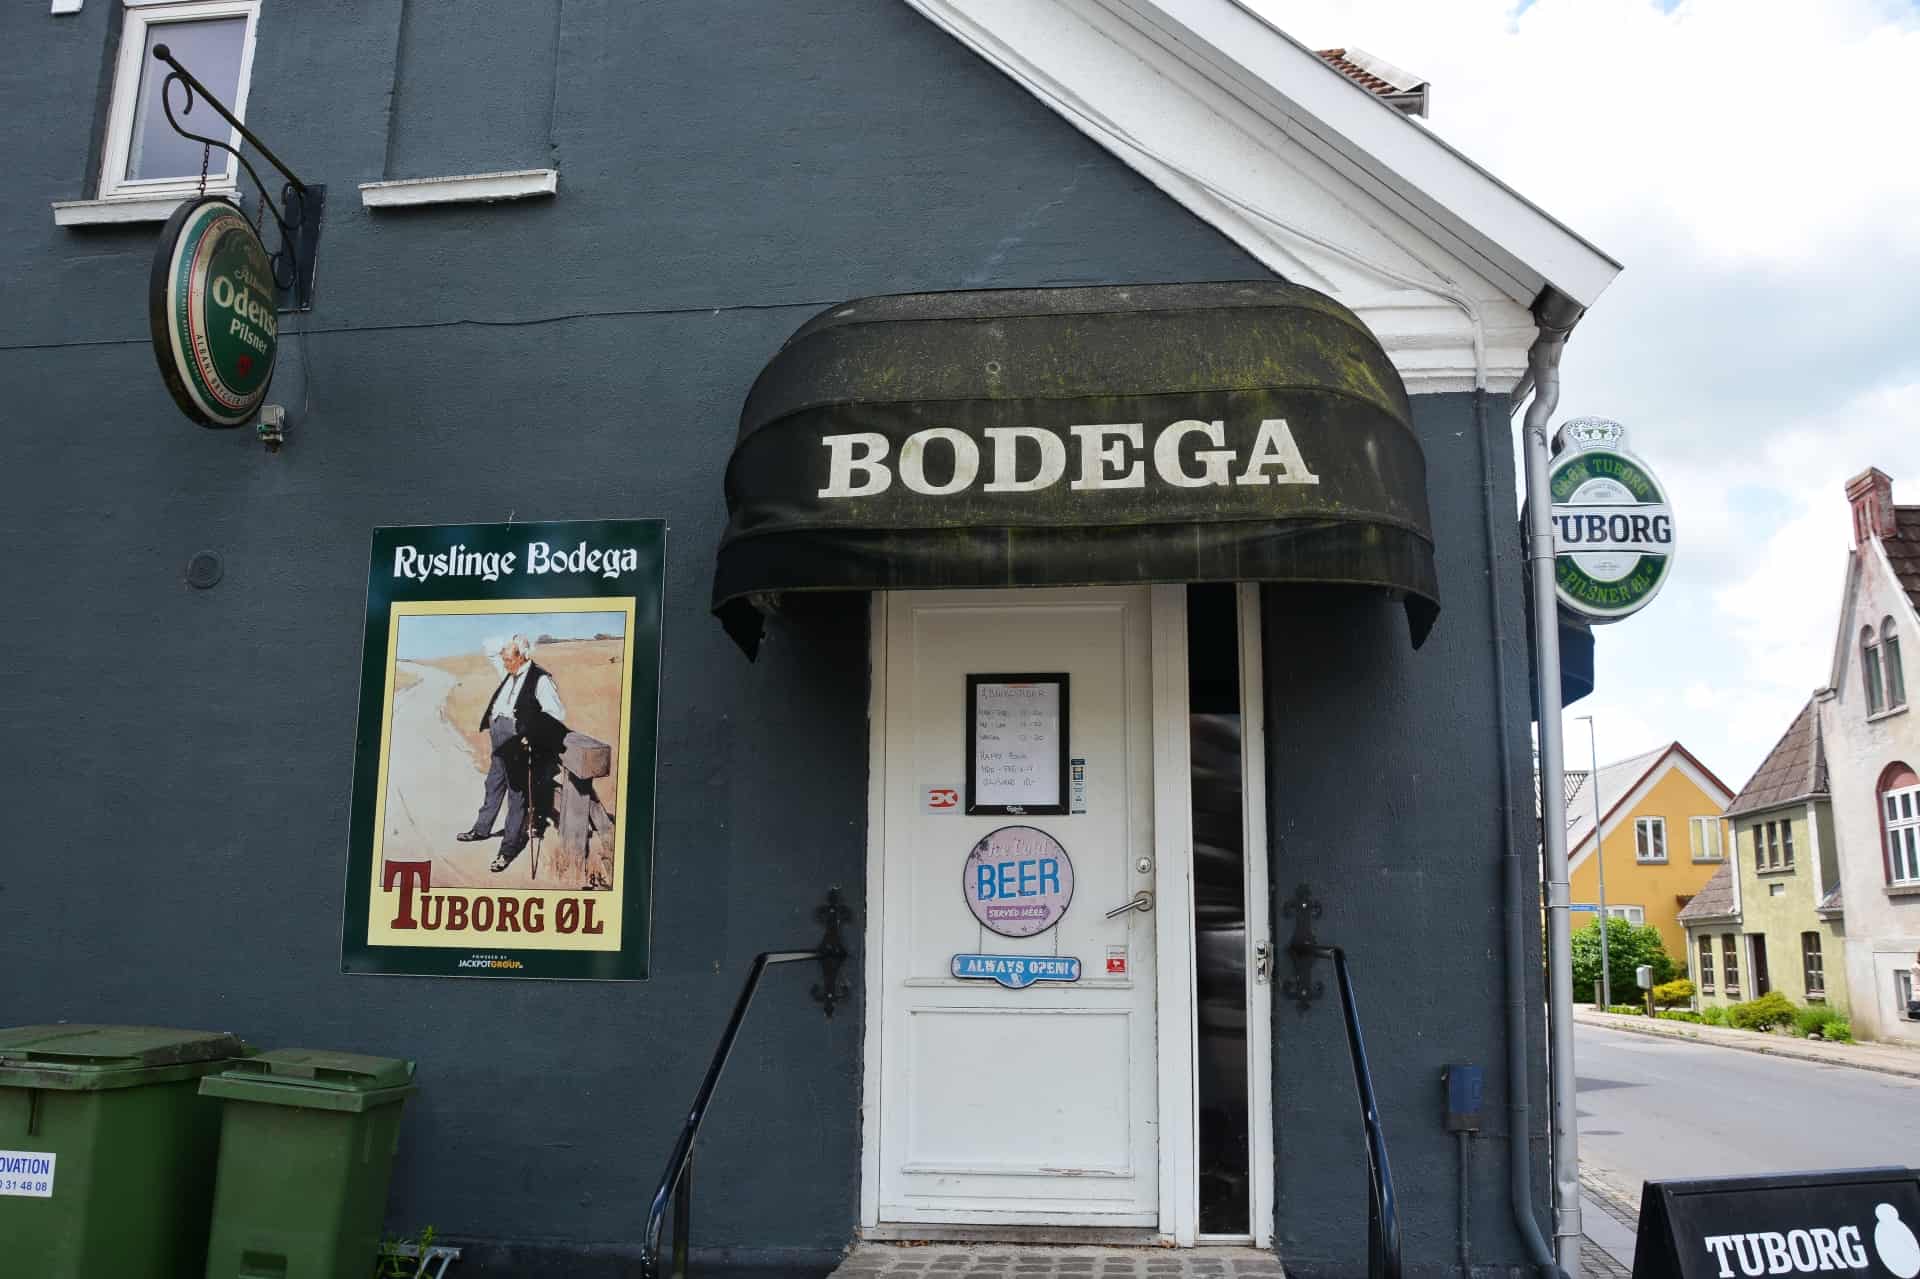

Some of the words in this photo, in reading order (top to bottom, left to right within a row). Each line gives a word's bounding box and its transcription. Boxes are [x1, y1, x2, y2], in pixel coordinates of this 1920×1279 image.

[230, 317, 268, 355] Pilsner
[816, 418, 1320, 499] BODEGA
[1592, 458, 1648, 496] TUBORG
[1552, 514, 1671, 544] UBORG
[393, 543, 517, 582] Ryslinge
[526, 541, 638, 578] Bodega
[1565, 572, 1632, 602] PILSNER
[383, 859, 545, 934] TUBORG
[555, 897, 604, 935] ØL
[976, 857, 1060, 901] BEER
[967, 959, 1025, 974] ALWAYS
[1028, 961, 1069, 975] OPEN!
[5, 1180, 17, 1190] 31
[20, 1181, 33, 1191] 48
[35, 1182, 48, 1192] 08
[1704, 1225, 1869, 1279] TUBORG
